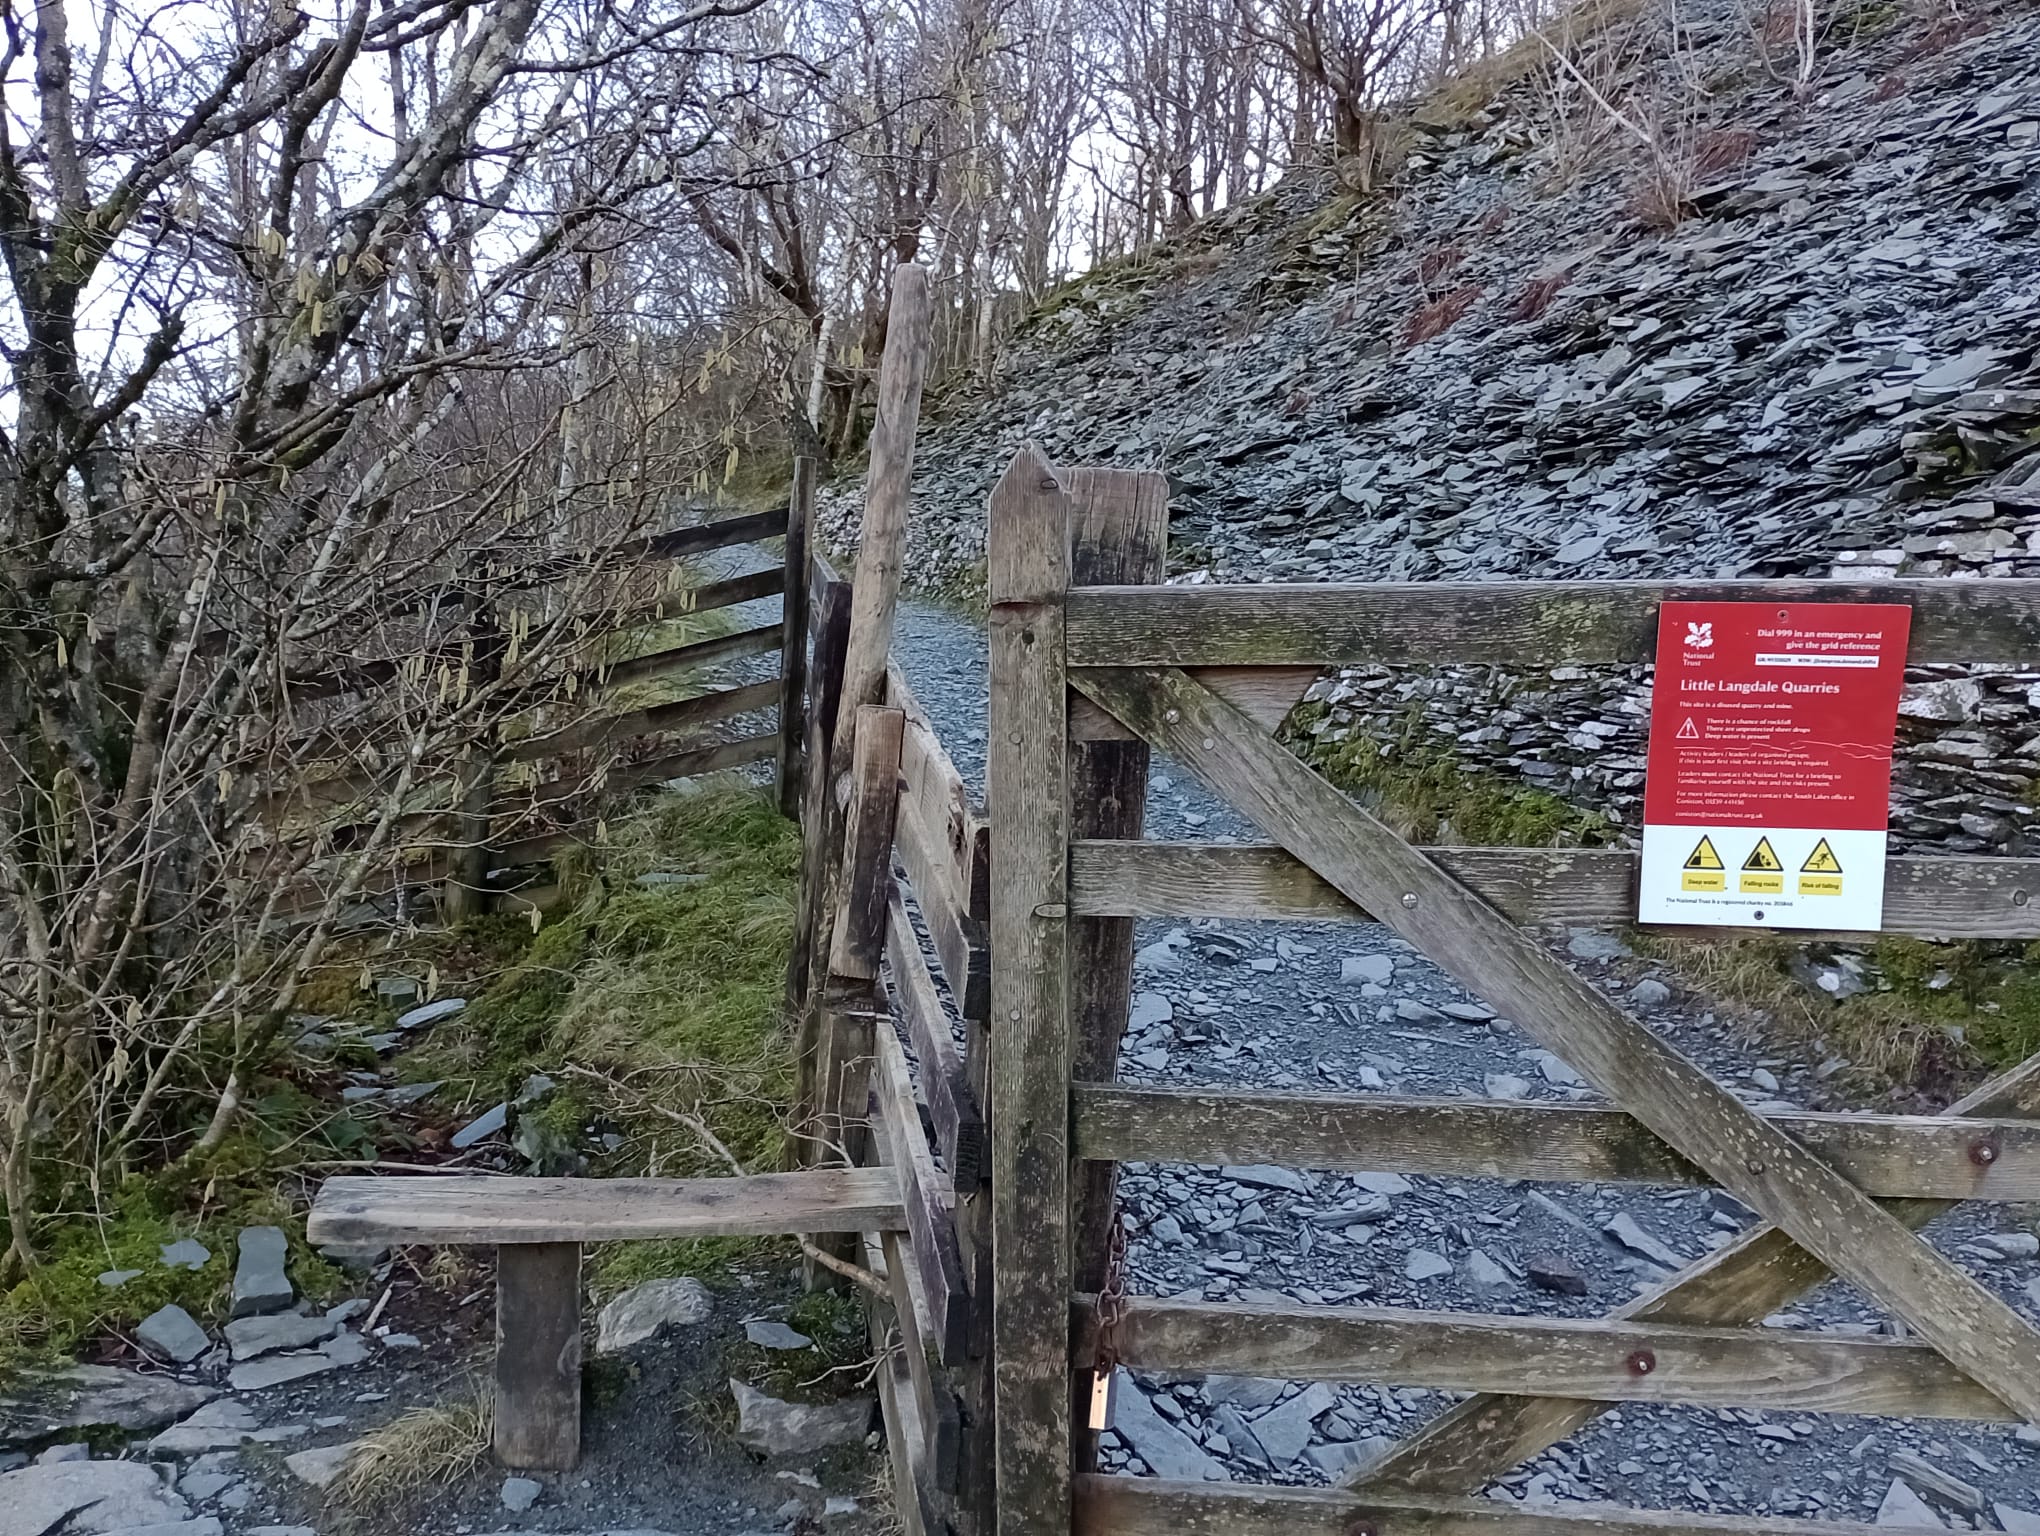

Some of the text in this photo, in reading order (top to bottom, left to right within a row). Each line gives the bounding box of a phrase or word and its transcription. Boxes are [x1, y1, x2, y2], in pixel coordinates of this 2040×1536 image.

[1757, 629, 1775, 637] Dial
[1776, 629, 1793, 637] 999
[1816, 631, 1863, 640] emergency
[1865, 631, 1882, 639] and
[1786, 640, 1881, 650] give the grid reference
[1683, 652, 1715, 660] National
[1683, 659, 1701, 667] Trust
[1680, 679, 1841, 695] Little Langdale Quarries
[1680, 750, 1702, 758] Activity
[1743, 880, 1762, 888] Falling
